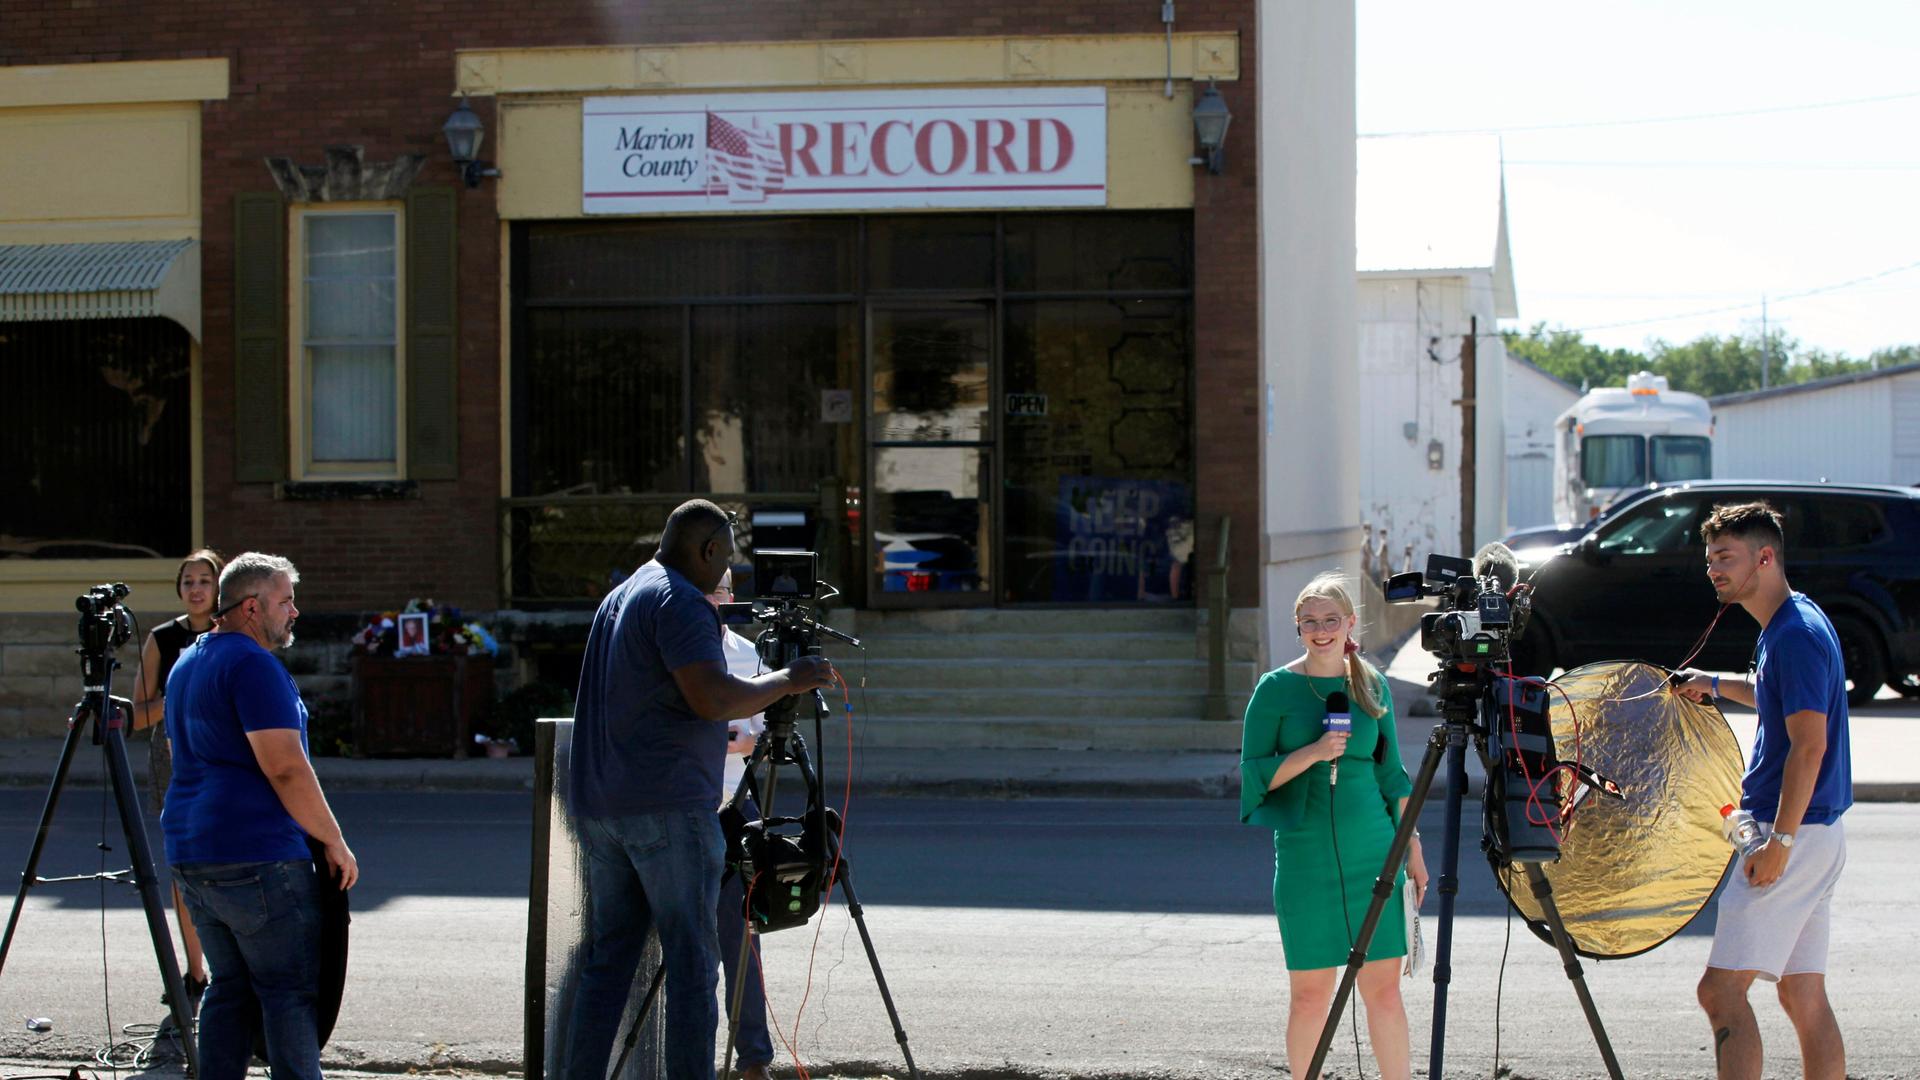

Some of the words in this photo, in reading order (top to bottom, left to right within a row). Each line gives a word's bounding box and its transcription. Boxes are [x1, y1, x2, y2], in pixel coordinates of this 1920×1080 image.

[615, 125, 695, 151] Marion
[776, 118, 1075, 177] RECORD
[622, 153, 699, 183] County
[1008, 396, 1045, 413] OPEN
